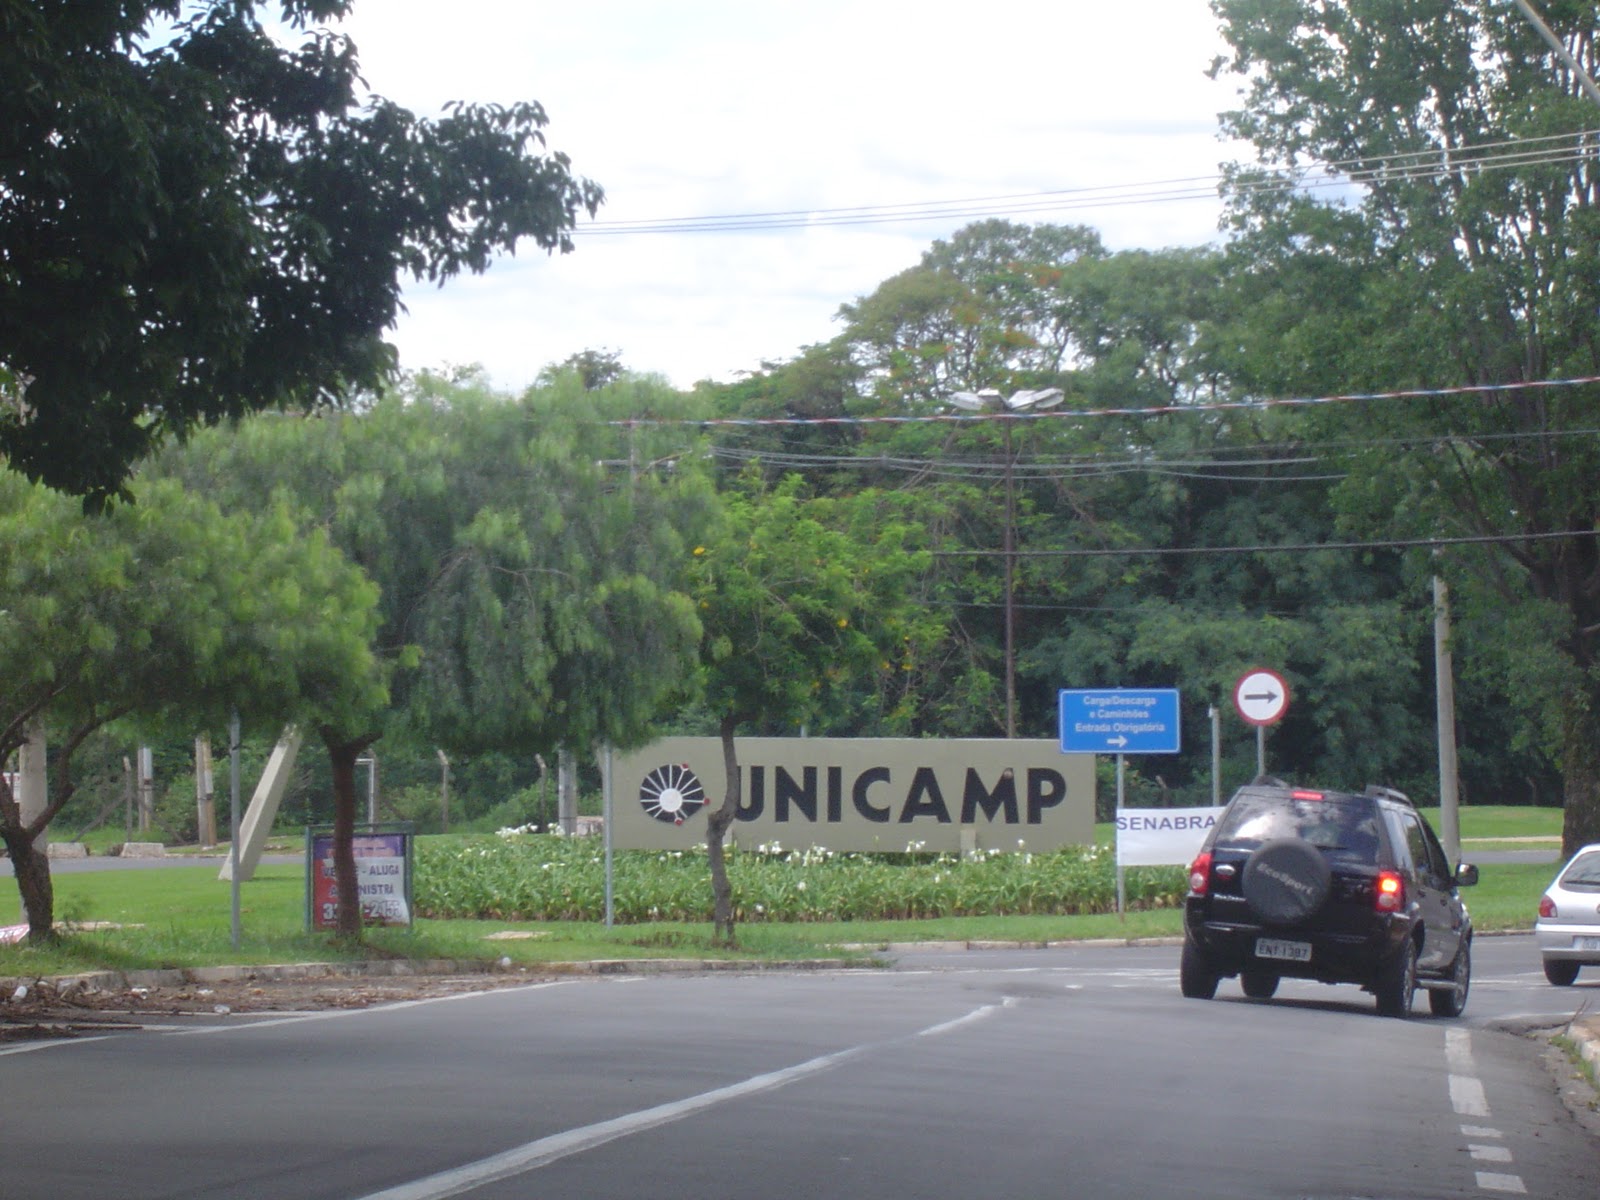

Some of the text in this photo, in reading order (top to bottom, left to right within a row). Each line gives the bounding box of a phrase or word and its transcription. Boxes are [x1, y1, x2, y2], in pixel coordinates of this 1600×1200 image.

[1083, 695, 1156, 707] Carga/Descarga
[1089, 709, 1149, 719] e Caminhões
[1075, 722, 1165, 734] Entrada Obrigatória
[734, 765, 1066, 824] UNICAMP
[369, 865, 399, 875] ALUGA
